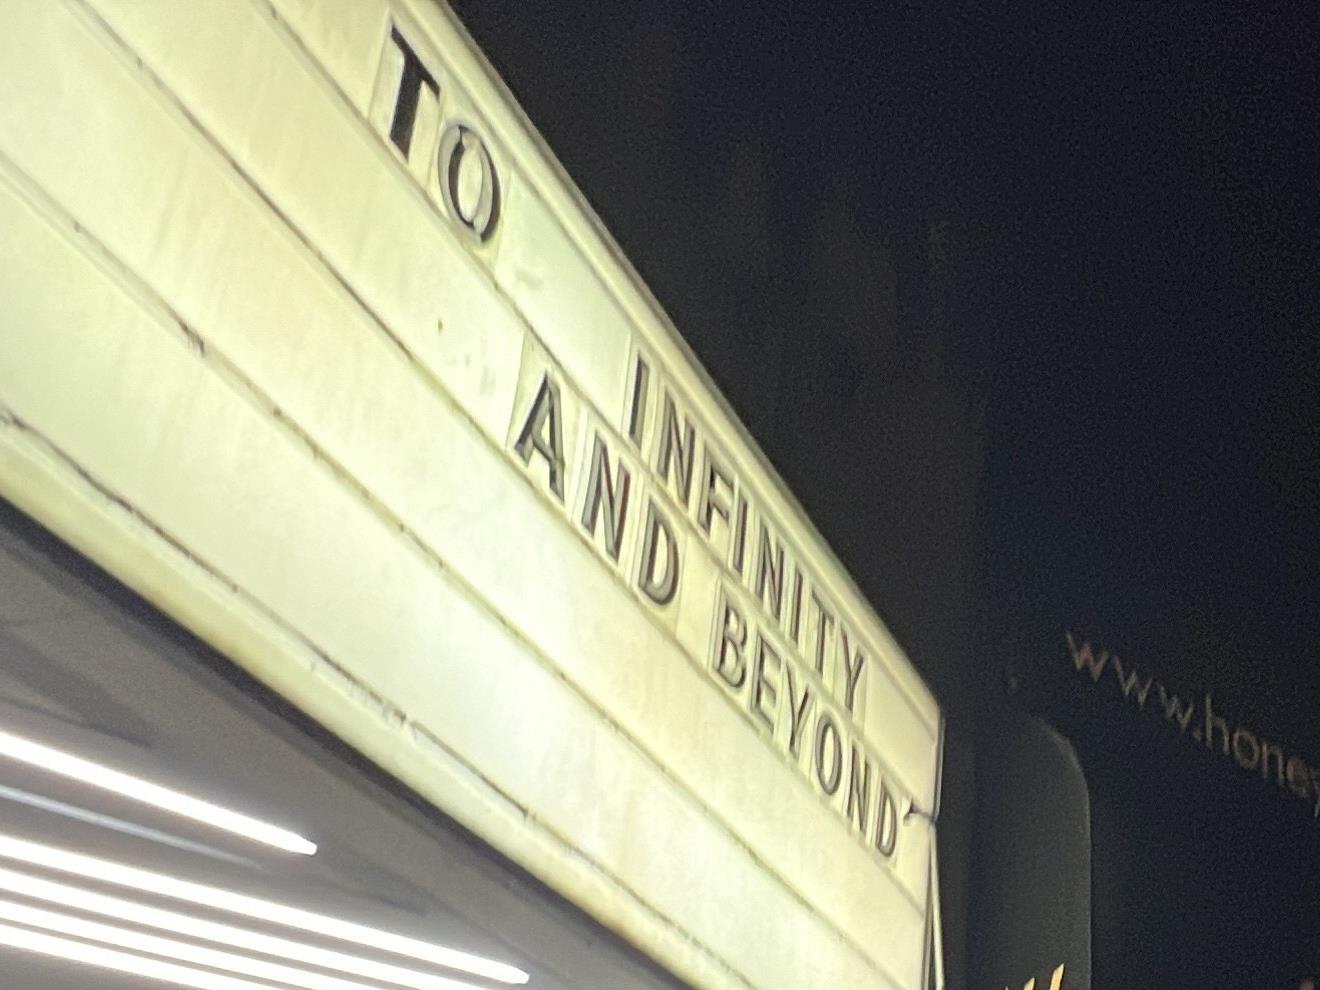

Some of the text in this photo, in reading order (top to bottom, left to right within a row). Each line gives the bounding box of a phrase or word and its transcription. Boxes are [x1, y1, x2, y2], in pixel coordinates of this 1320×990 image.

[388, 26, 867, 710] TO INFINITY
[514, 370, 899, 860] AND BEYOND
